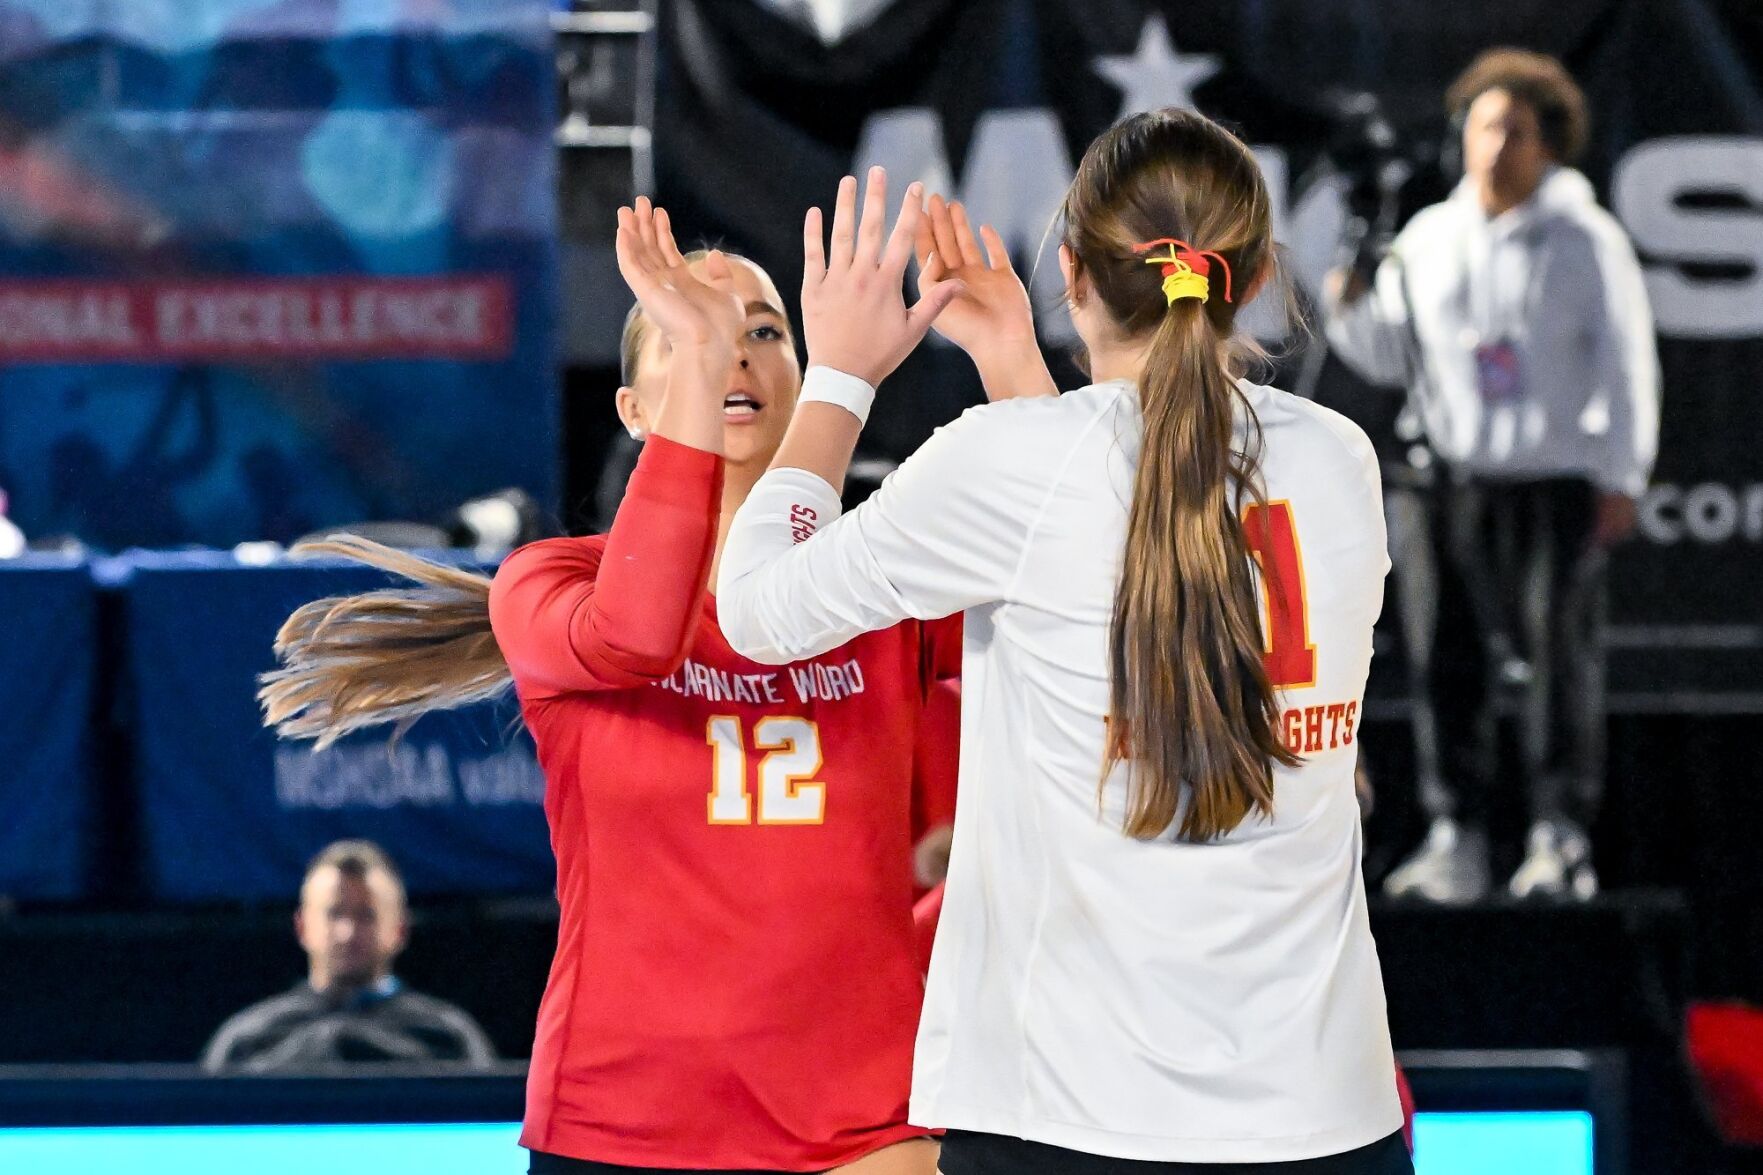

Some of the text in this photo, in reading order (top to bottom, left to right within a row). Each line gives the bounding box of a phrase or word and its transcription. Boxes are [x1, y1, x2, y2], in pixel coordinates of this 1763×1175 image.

[156, 288, 486, 344] EXCELLENCE
[790, 503, 817, 546] GHTS
[1640, 483, 1763, 543] co
[650, 657, 865, 704] CARNATE WORD
[1282, 700, 1357, 754] GHTS
[706, 714, 826, 825] 12
